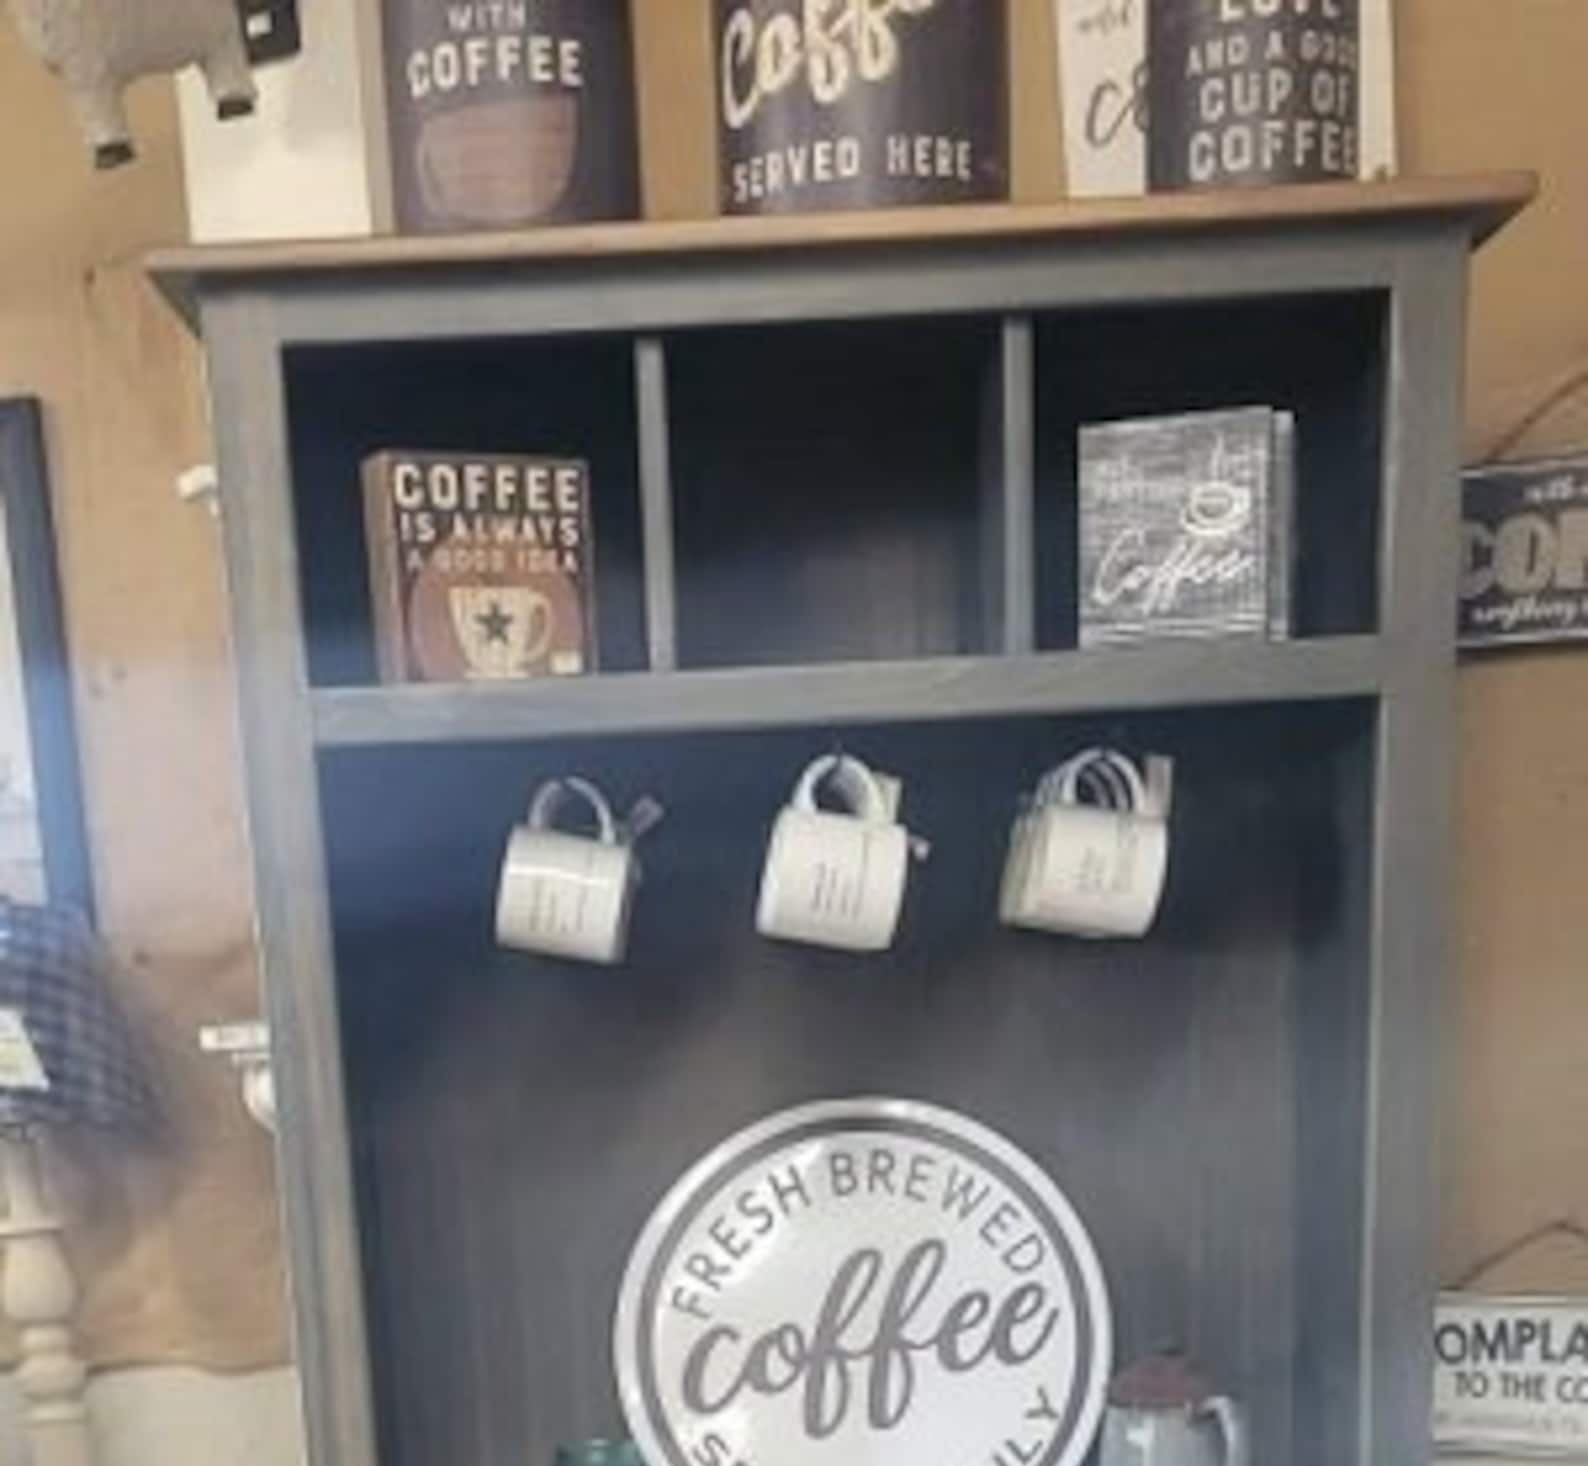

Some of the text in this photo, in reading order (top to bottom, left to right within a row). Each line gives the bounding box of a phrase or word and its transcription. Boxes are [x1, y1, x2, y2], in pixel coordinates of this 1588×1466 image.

[447, 0, 526, 32] WITH
[406, 36, 583, 99] COFFEE
[1185, 35, 1250, 80] AND
[1265, 30, 1285, 60] A
[1200, 67, 1294, 123] CUP
[1311, 69, 1350, 117] OF
[733, 135, 972, 203] SERVED HERE
[1188, 119, 1358, 183] COFFEE
[394, 462, 581, 512] COFFEE
[400, 511, 580, 547] IS ALWAYS
[405, 549, 425, 574] A
[672, 1149, 1048, 1321] FRESH BREWED
[682, 1237, 1060, 1440] coffee
[1455, 1371, 1489, 1398] TO
[1501, 1371, 1546, 1402] THE
